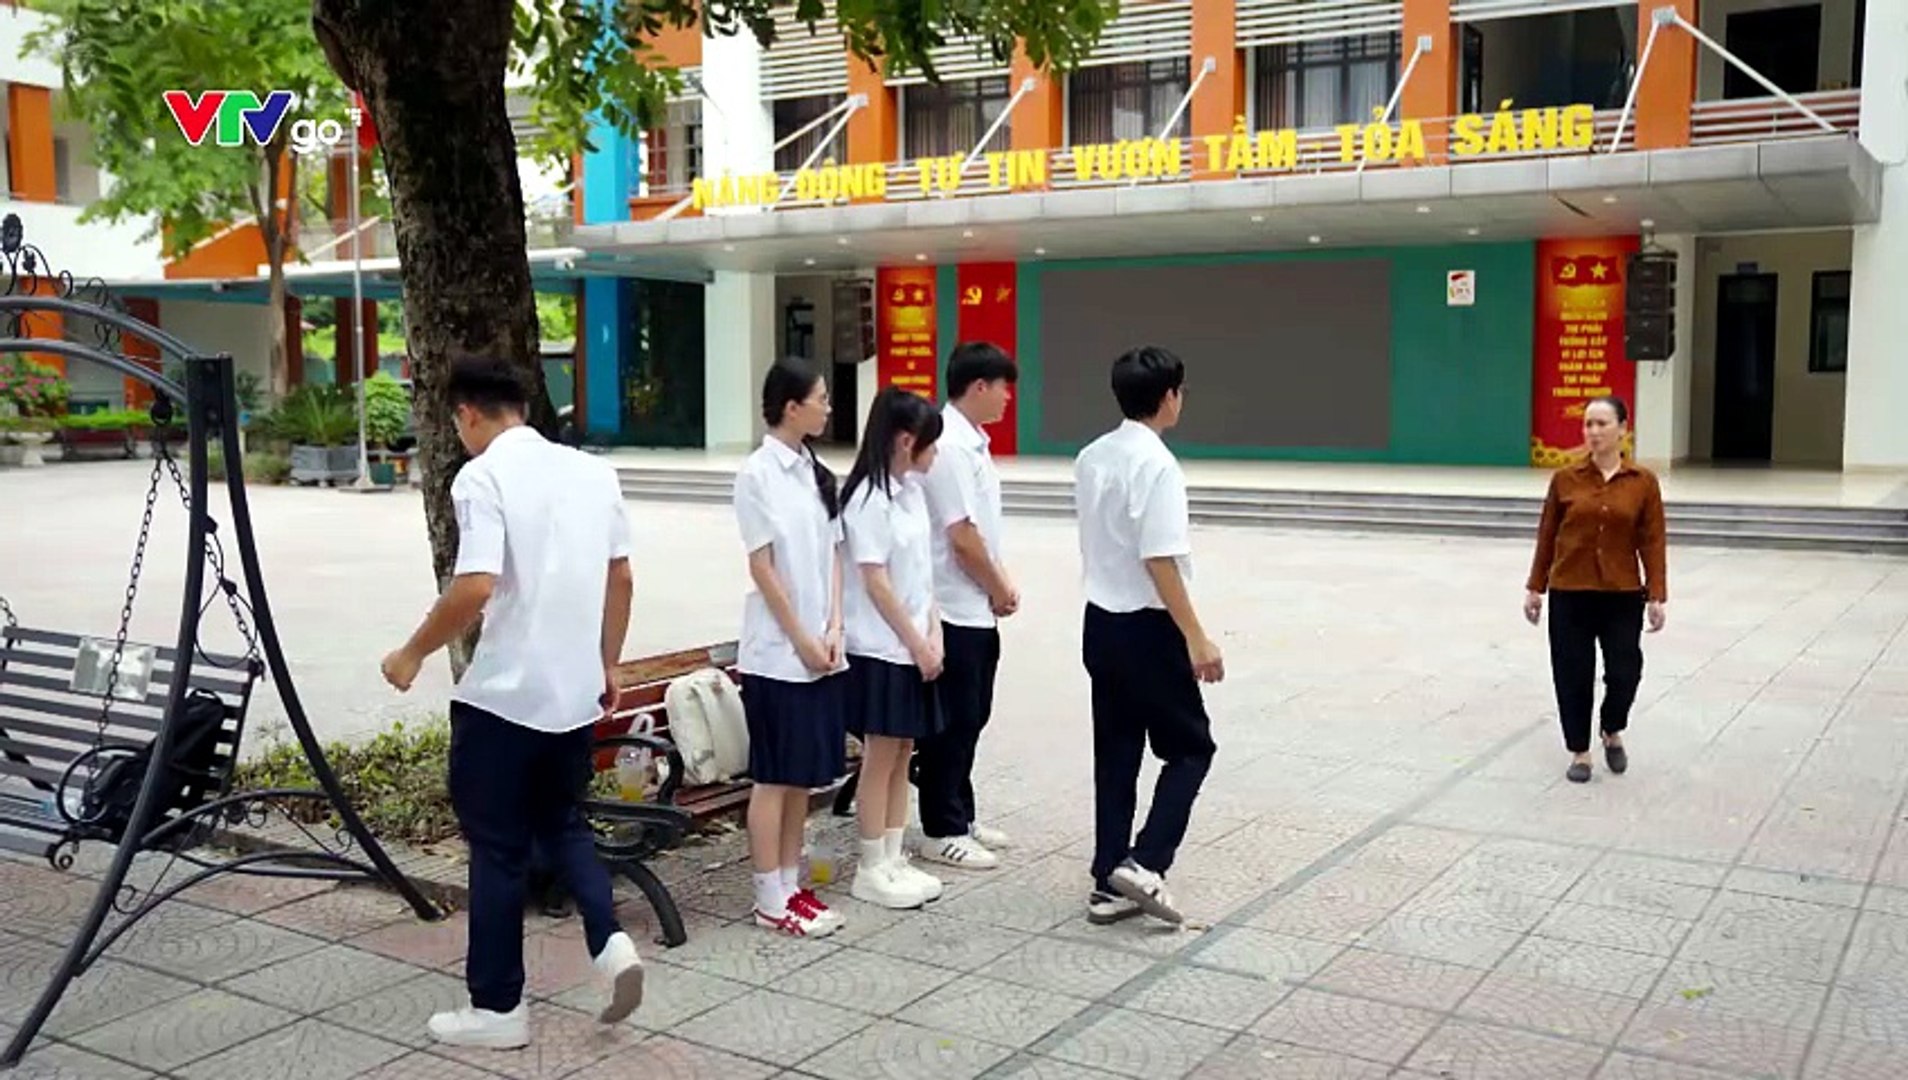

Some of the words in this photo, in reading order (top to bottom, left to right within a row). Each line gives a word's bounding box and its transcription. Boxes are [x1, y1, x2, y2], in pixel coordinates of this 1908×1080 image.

[986, 149, 1047, 187] TIN
[1335, 106, 1425, 163] TỎA
[1454, 99, 1594, 155] SÁNG
